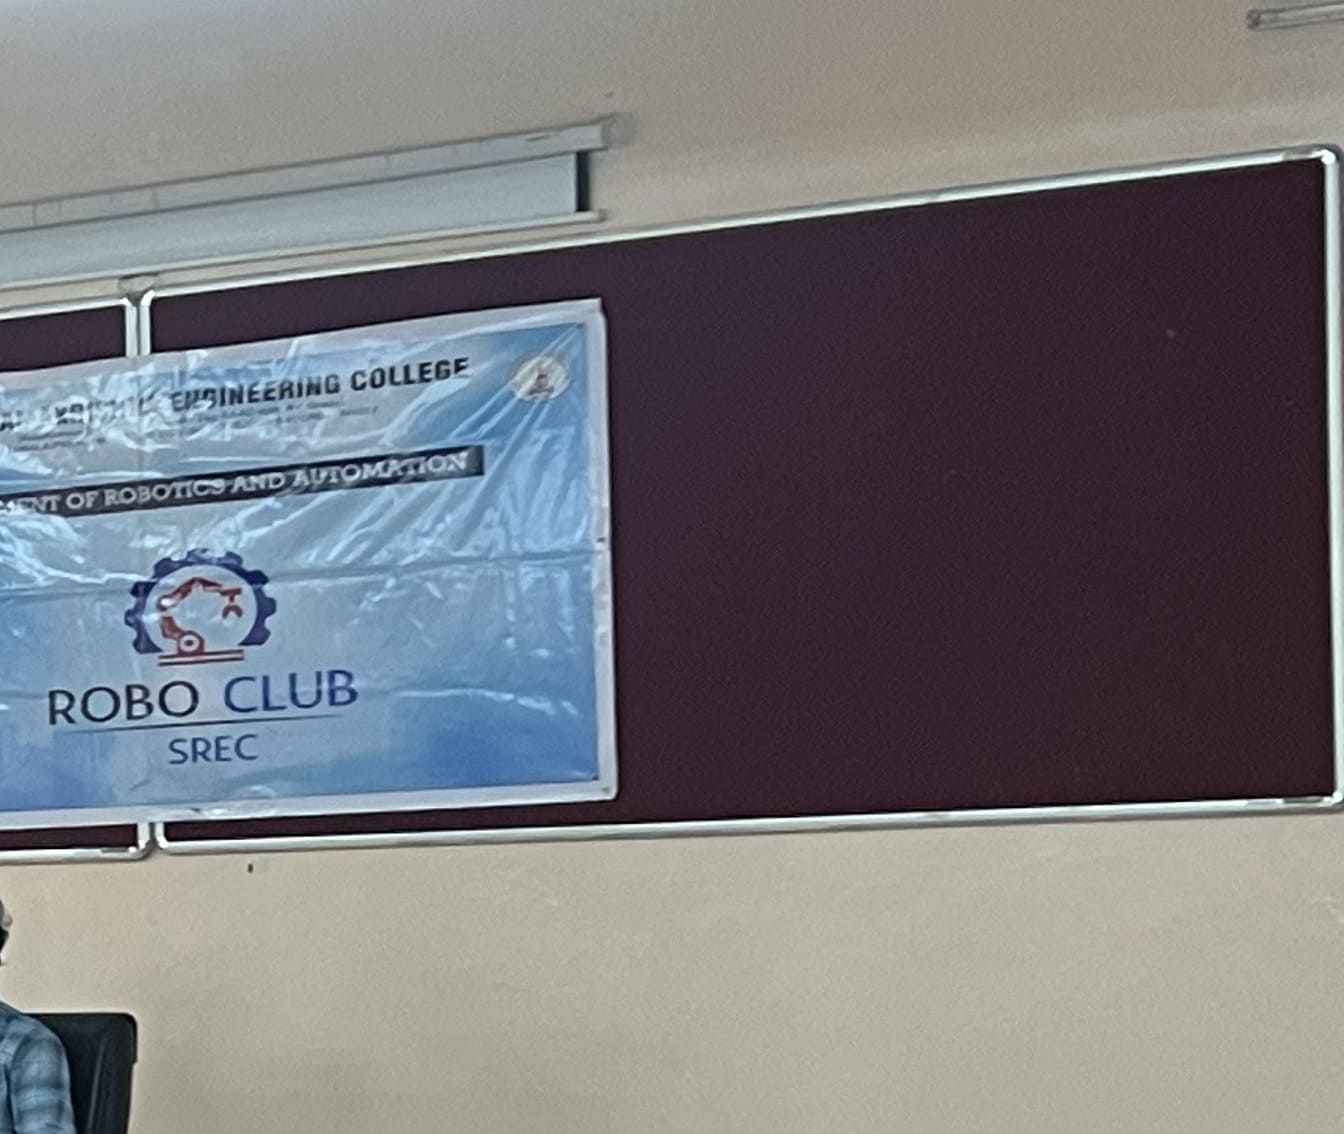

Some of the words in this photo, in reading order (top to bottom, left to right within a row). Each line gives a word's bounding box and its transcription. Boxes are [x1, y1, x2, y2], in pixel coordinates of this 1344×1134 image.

[350, 356, 470, 392] COLLEGE
[65, 490, 99, 510] OF
[103, 478, 226, 507] ROBOTICS
[230, 471, 286, 494] AND
[292, 450, 470, 488] AUTOMATION
[48, 680, 200, 726] ROBO
[223, 669, 359, 714] CLUB
[167, 733, 260, 766] SREC
